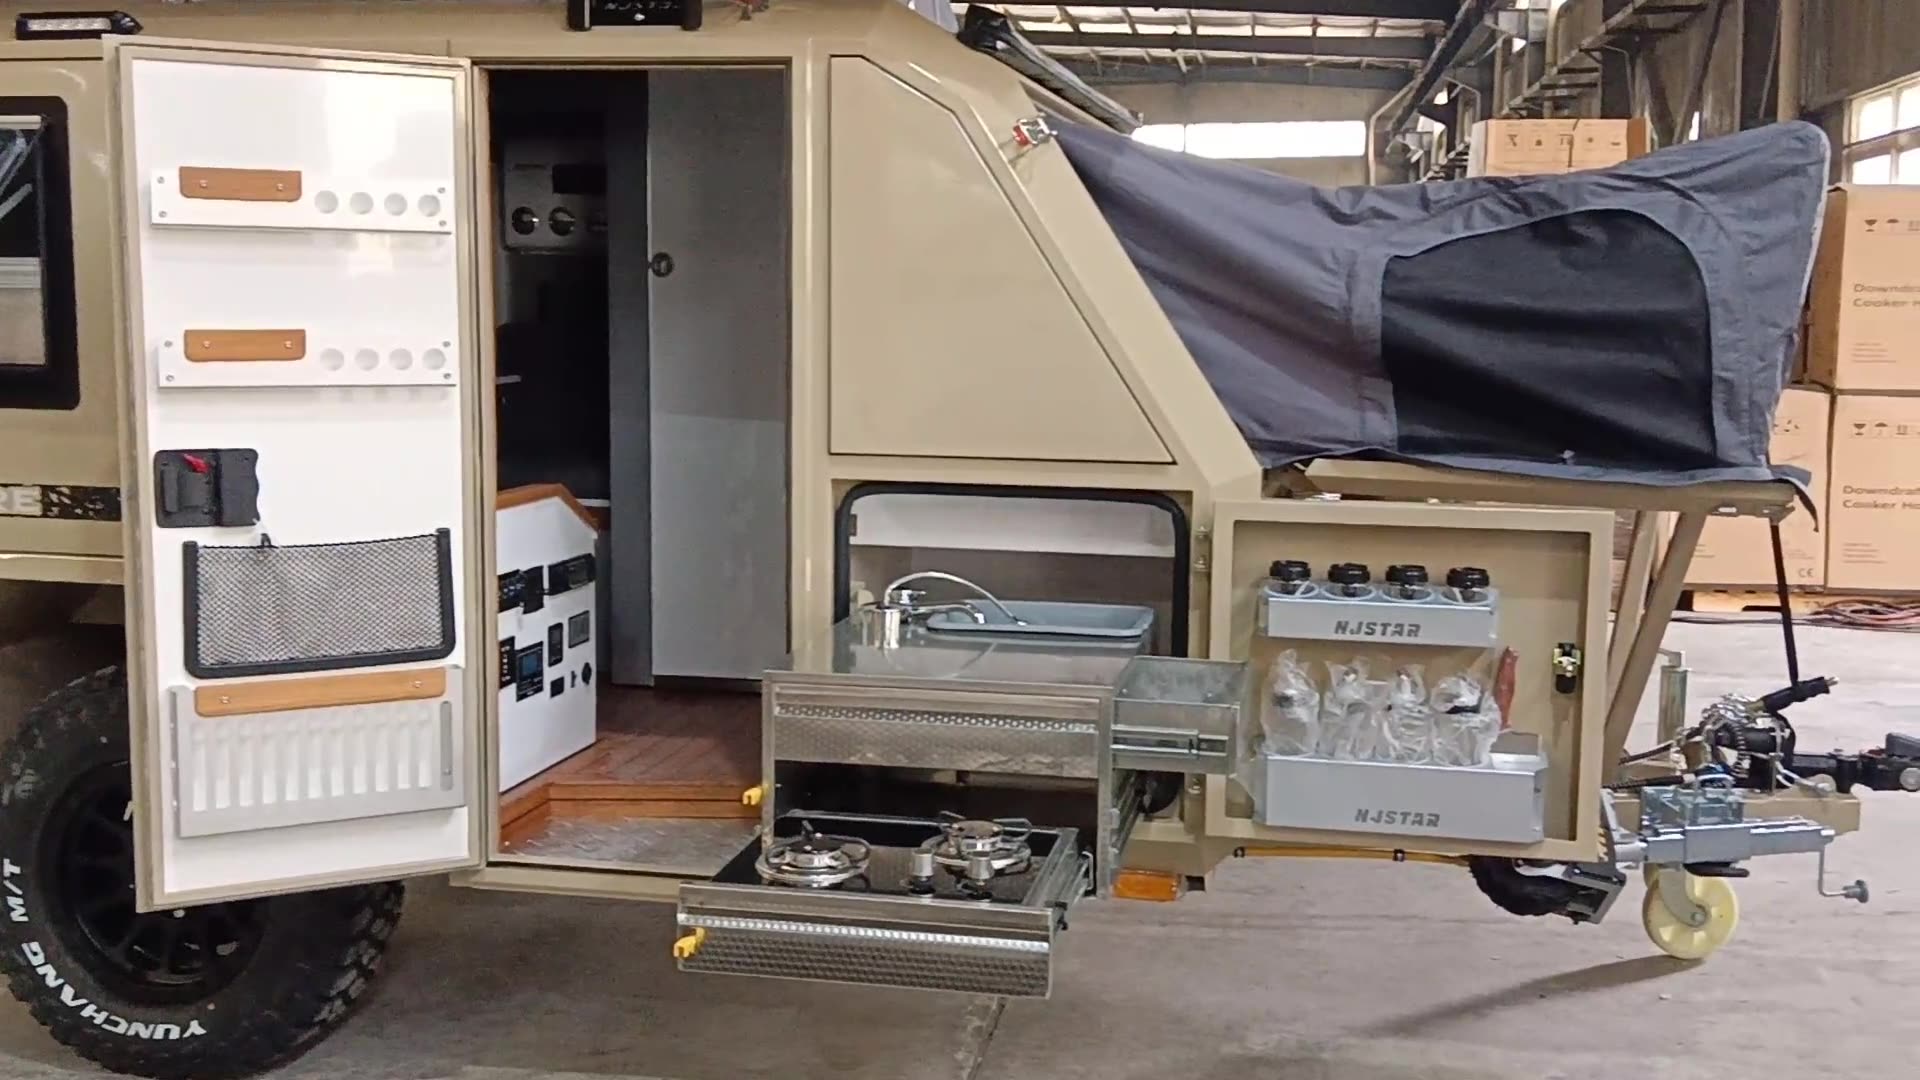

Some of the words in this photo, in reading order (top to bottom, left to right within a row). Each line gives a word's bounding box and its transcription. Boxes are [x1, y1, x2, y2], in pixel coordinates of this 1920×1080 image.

[1334, 620, 1421, 637] NJSTAR
[1354, 808, 1440, 827] NJSTAR
[3, 858, 29, 922] M/T
[21, 941, 207, 1040] YUNCHANG
